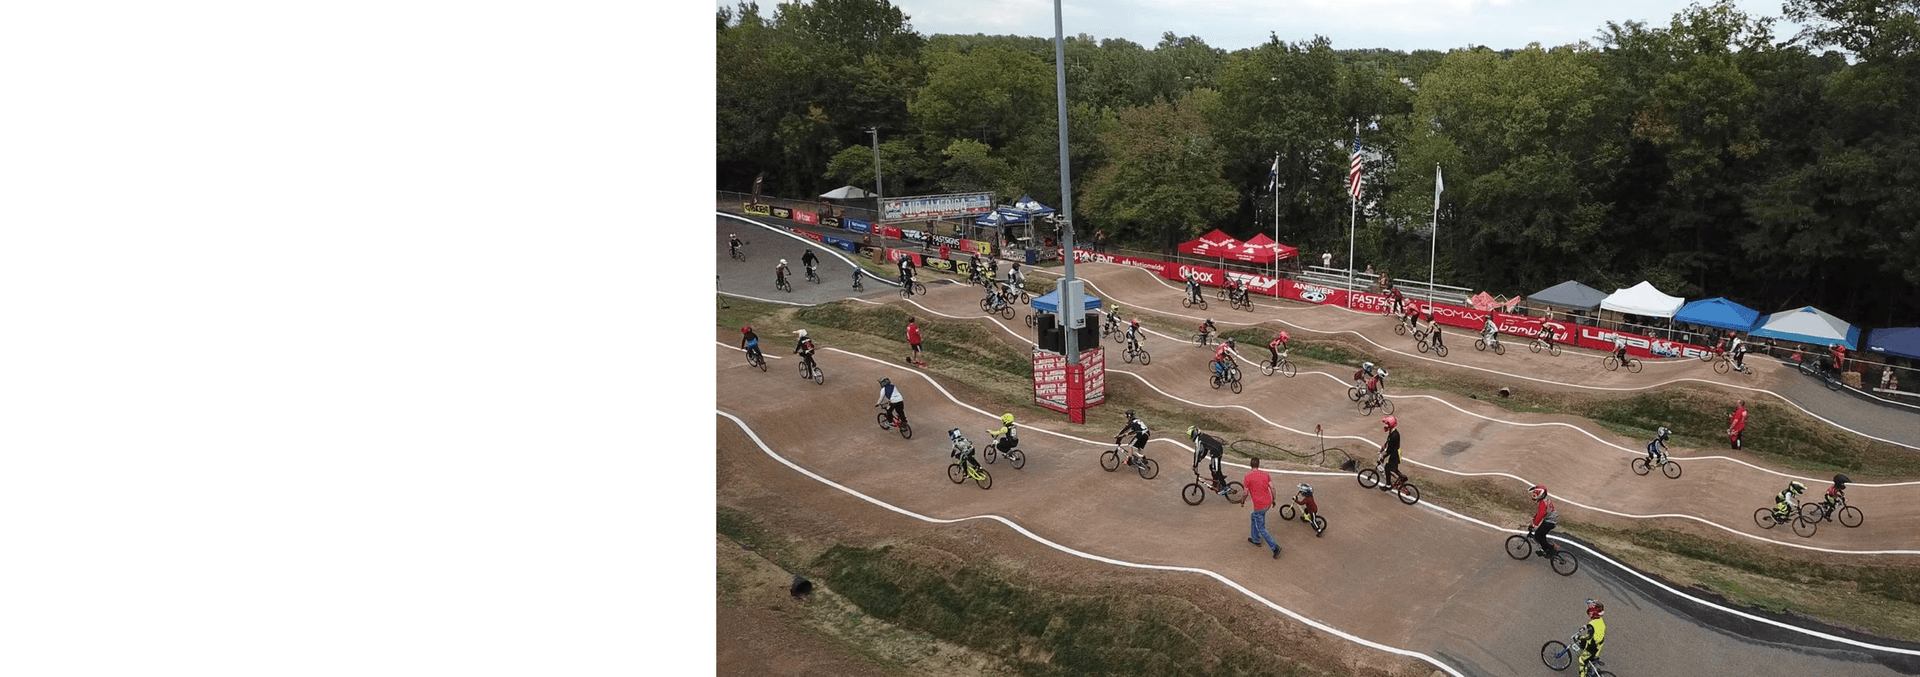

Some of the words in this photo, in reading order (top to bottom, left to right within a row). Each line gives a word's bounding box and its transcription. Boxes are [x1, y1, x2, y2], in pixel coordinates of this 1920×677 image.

[925, 198, 967, 214] AMERICA
[932, 234, 960, 246] FASTSIGNS
[1132, 260, 1164, 271] Nationwide
[1191, 267, 1213, 283] box
[1293, 282, 1335, 296] ANSWER
